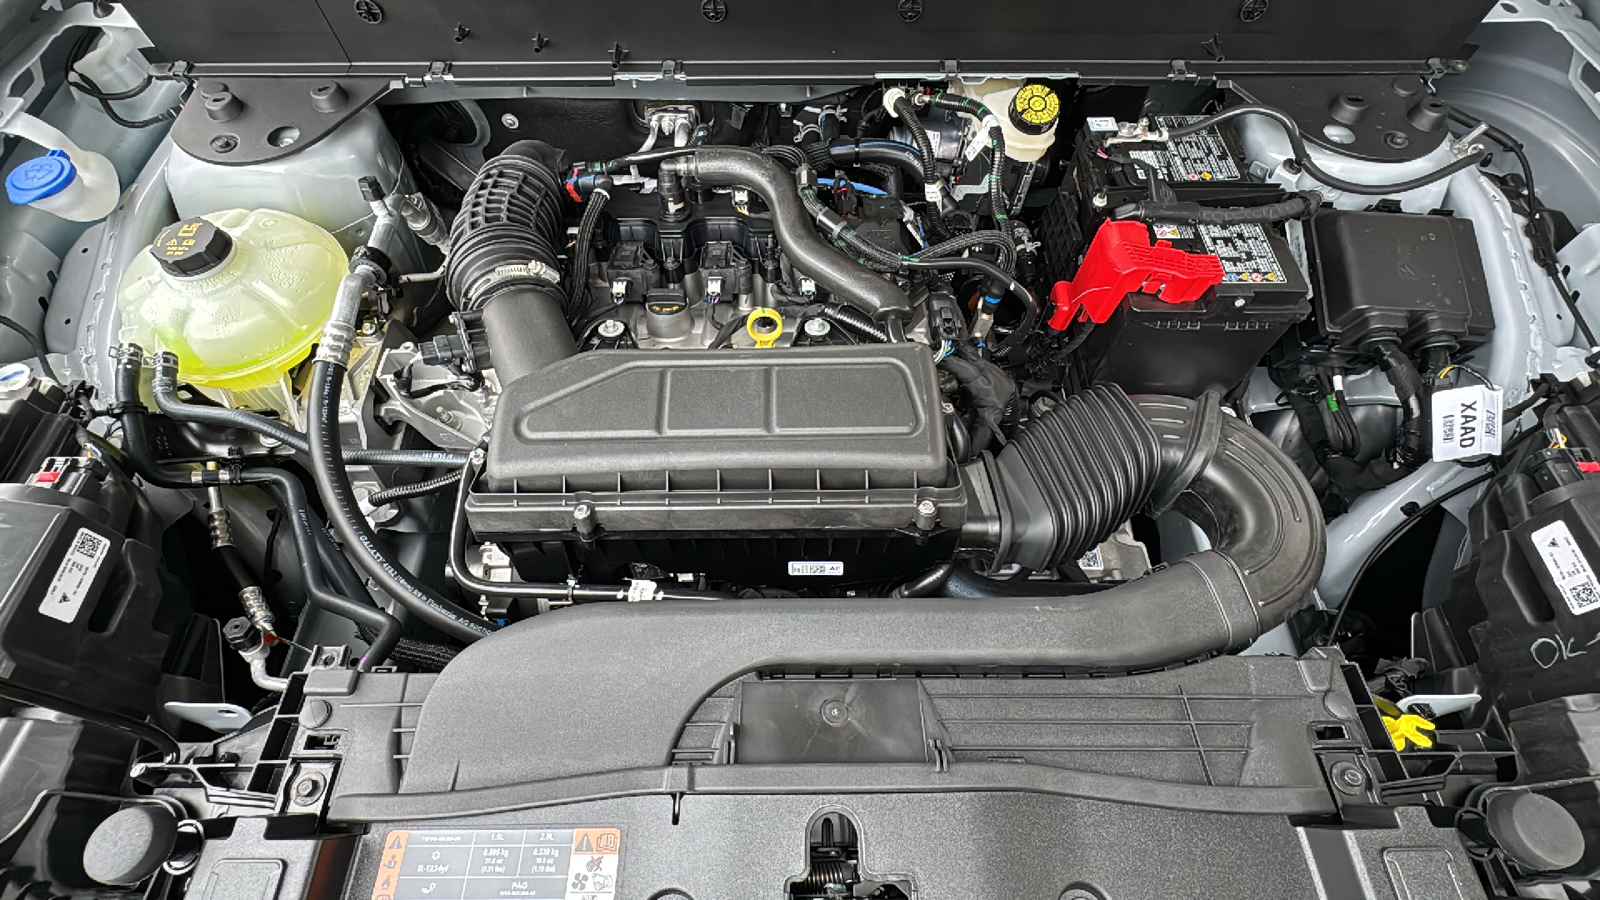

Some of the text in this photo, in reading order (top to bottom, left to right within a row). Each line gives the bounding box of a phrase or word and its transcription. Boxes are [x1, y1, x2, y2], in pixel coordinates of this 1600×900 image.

[1459, 401, 1478, 449] XAAD
[359, 535, 386, 566] GALAXY
[1531, 633, 1588, 669] OK
[417, 864, 449, 874] R-1234yf
